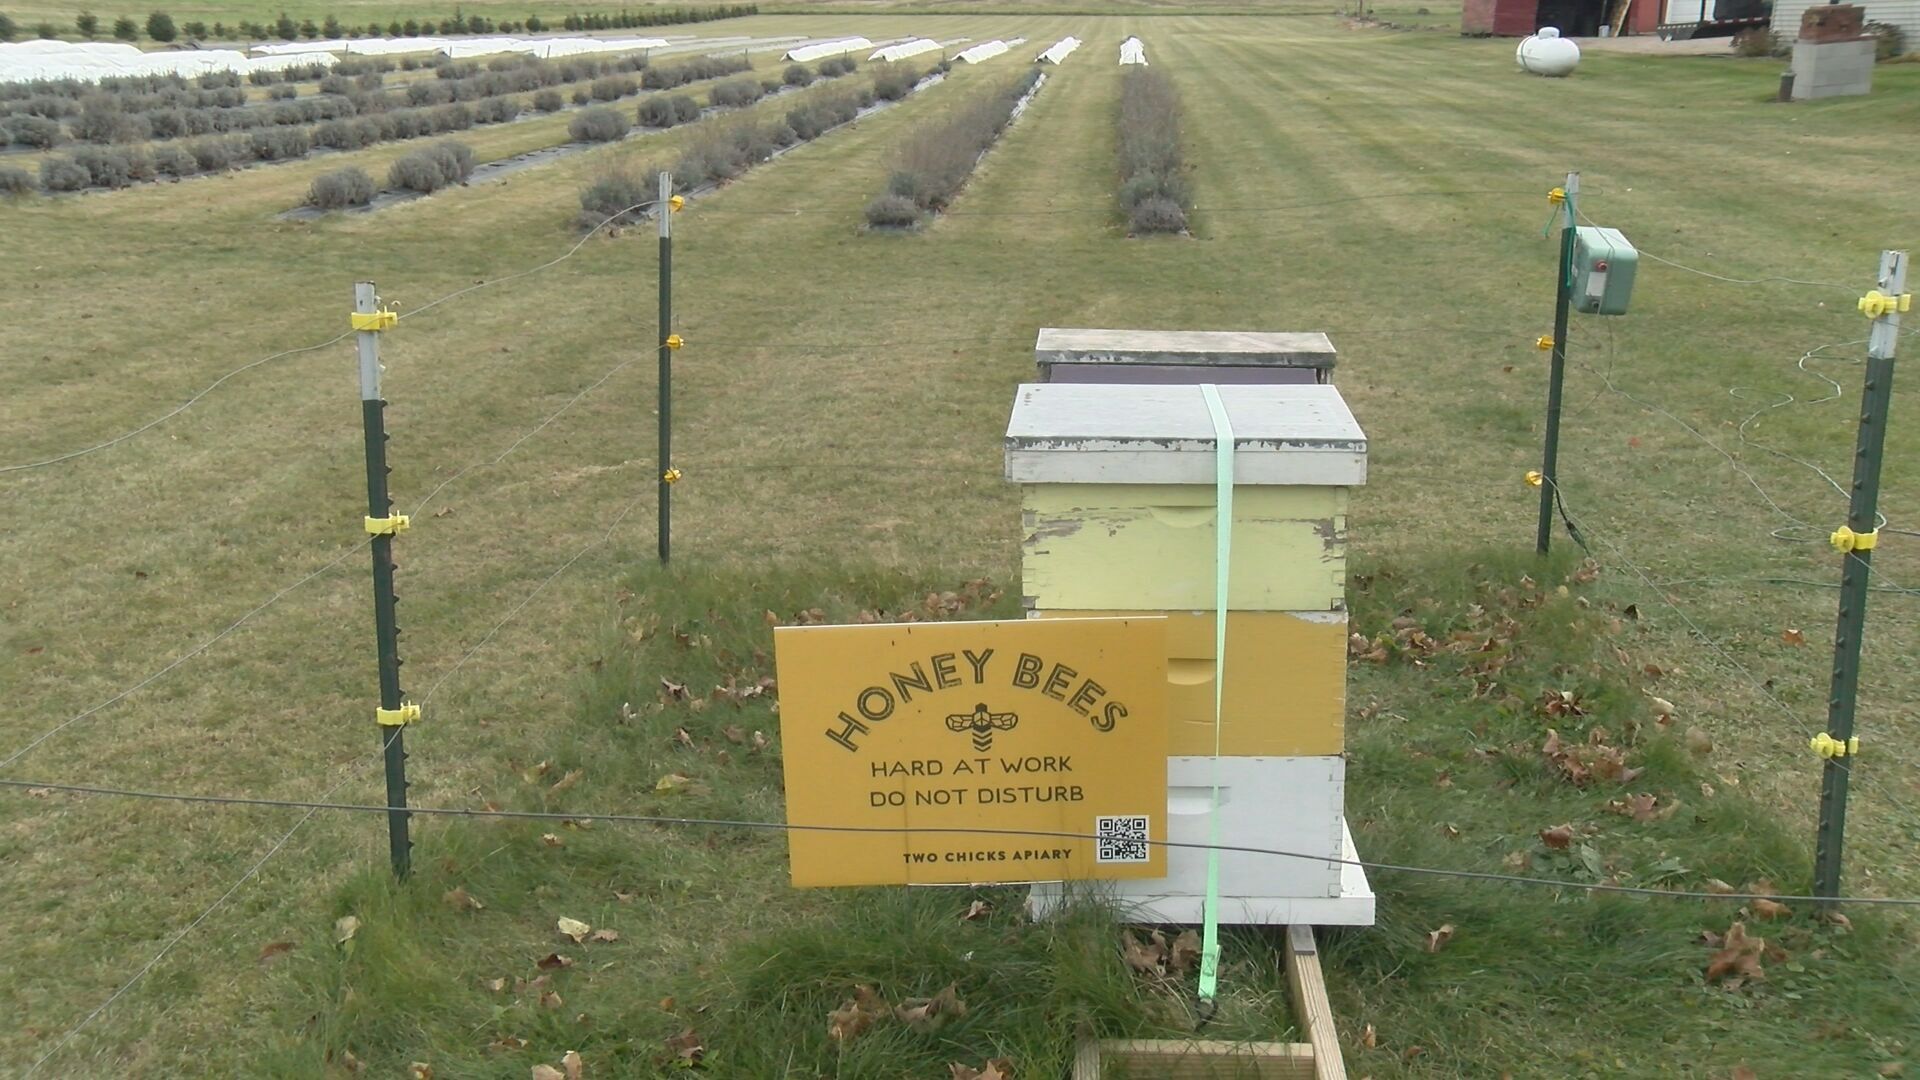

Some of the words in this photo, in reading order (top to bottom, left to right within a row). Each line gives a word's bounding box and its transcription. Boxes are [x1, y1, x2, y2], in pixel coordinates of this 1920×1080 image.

[825, 648, 994, 752] HONEY
[1012, 652, 1128, 733] BEES
[871, 759, 943, 777] HARD
[952, 758, 992, 775] AT
[1000, 756, 1072, 773] WORK
[870, 791, 905, 807] DO
[915, 789, 968, 805] NOT
[978, 786, 1084, 803] DISTURB
[903, 852, 938, 864] TWO
[945, 850, 1006, 863] CHICKS
[1012, 848, 1072, 861] APIARY
